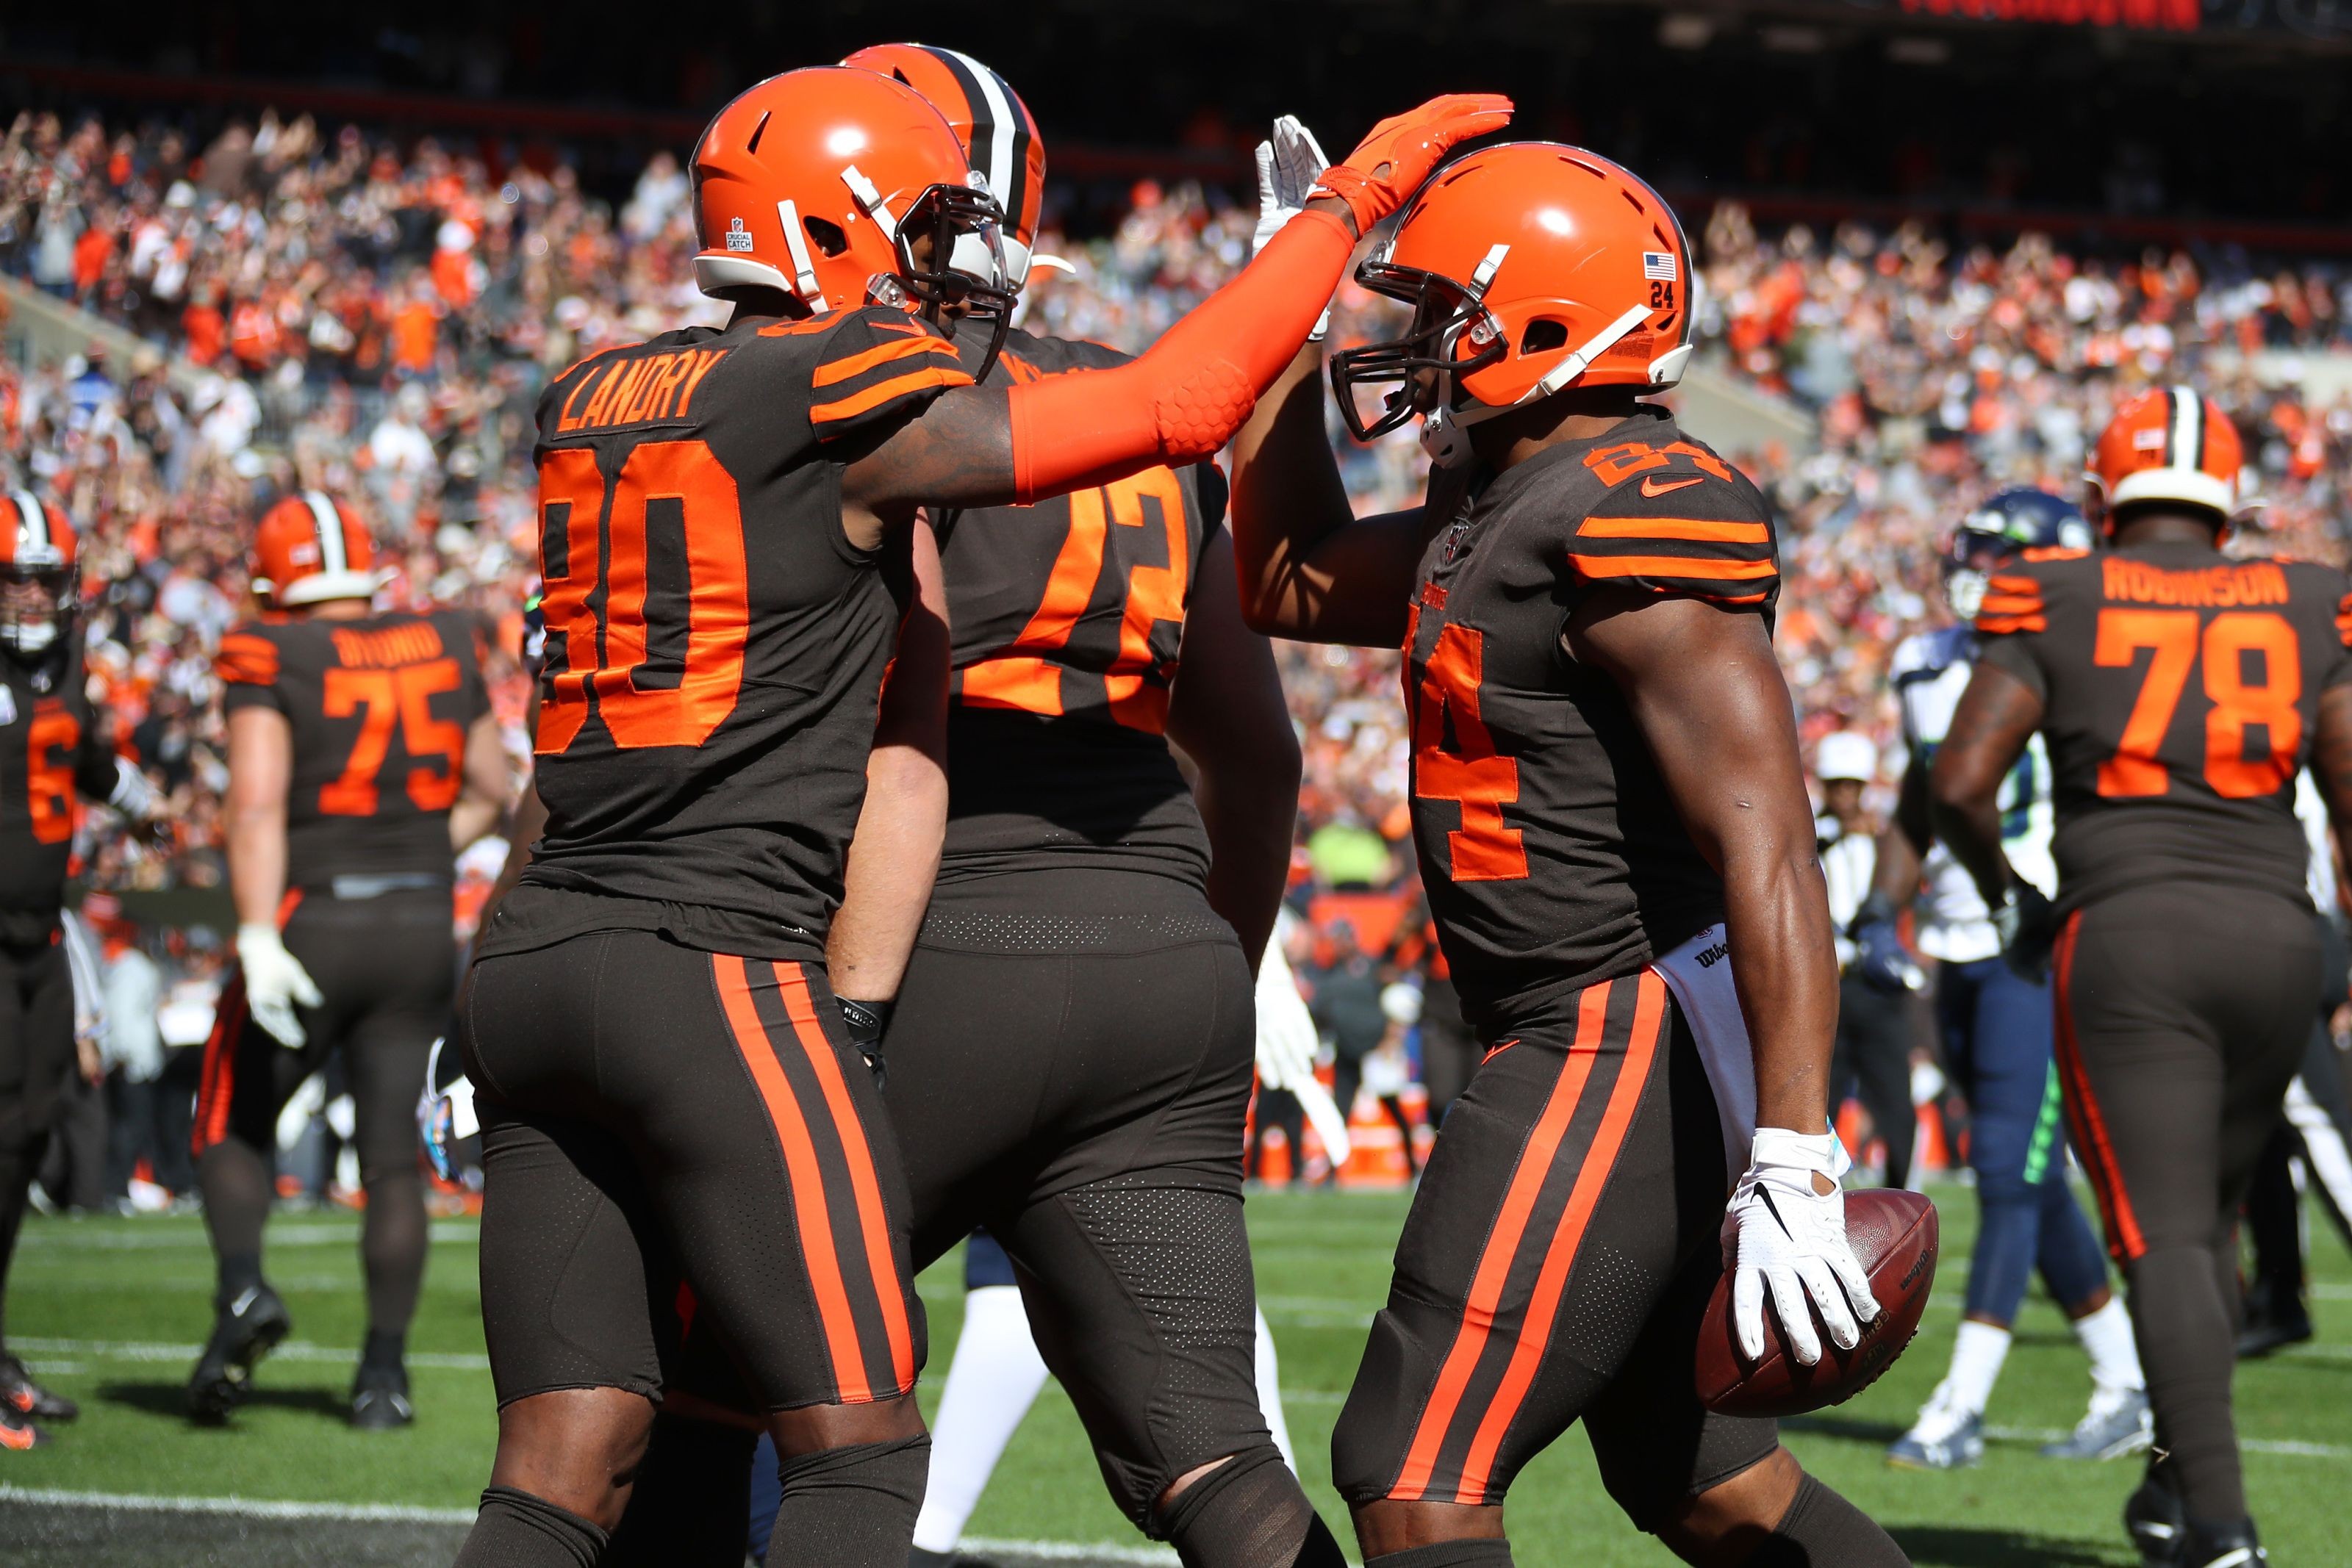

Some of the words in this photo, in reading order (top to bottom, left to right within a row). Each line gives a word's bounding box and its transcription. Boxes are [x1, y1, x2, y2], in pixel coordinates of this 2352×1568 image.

[728, 240, 751, 248] CATCH
[1650, 281, 1674, 309] 24
[556, 349, 728, 432] LANDRY
[534, 440, 750, 755] 80
[318, 656, 466, 817] 75
[1401, 602, 1529, 882] 4
[2093, 608, 2303, 799] 78
[27, 711, 81, 844] 6
